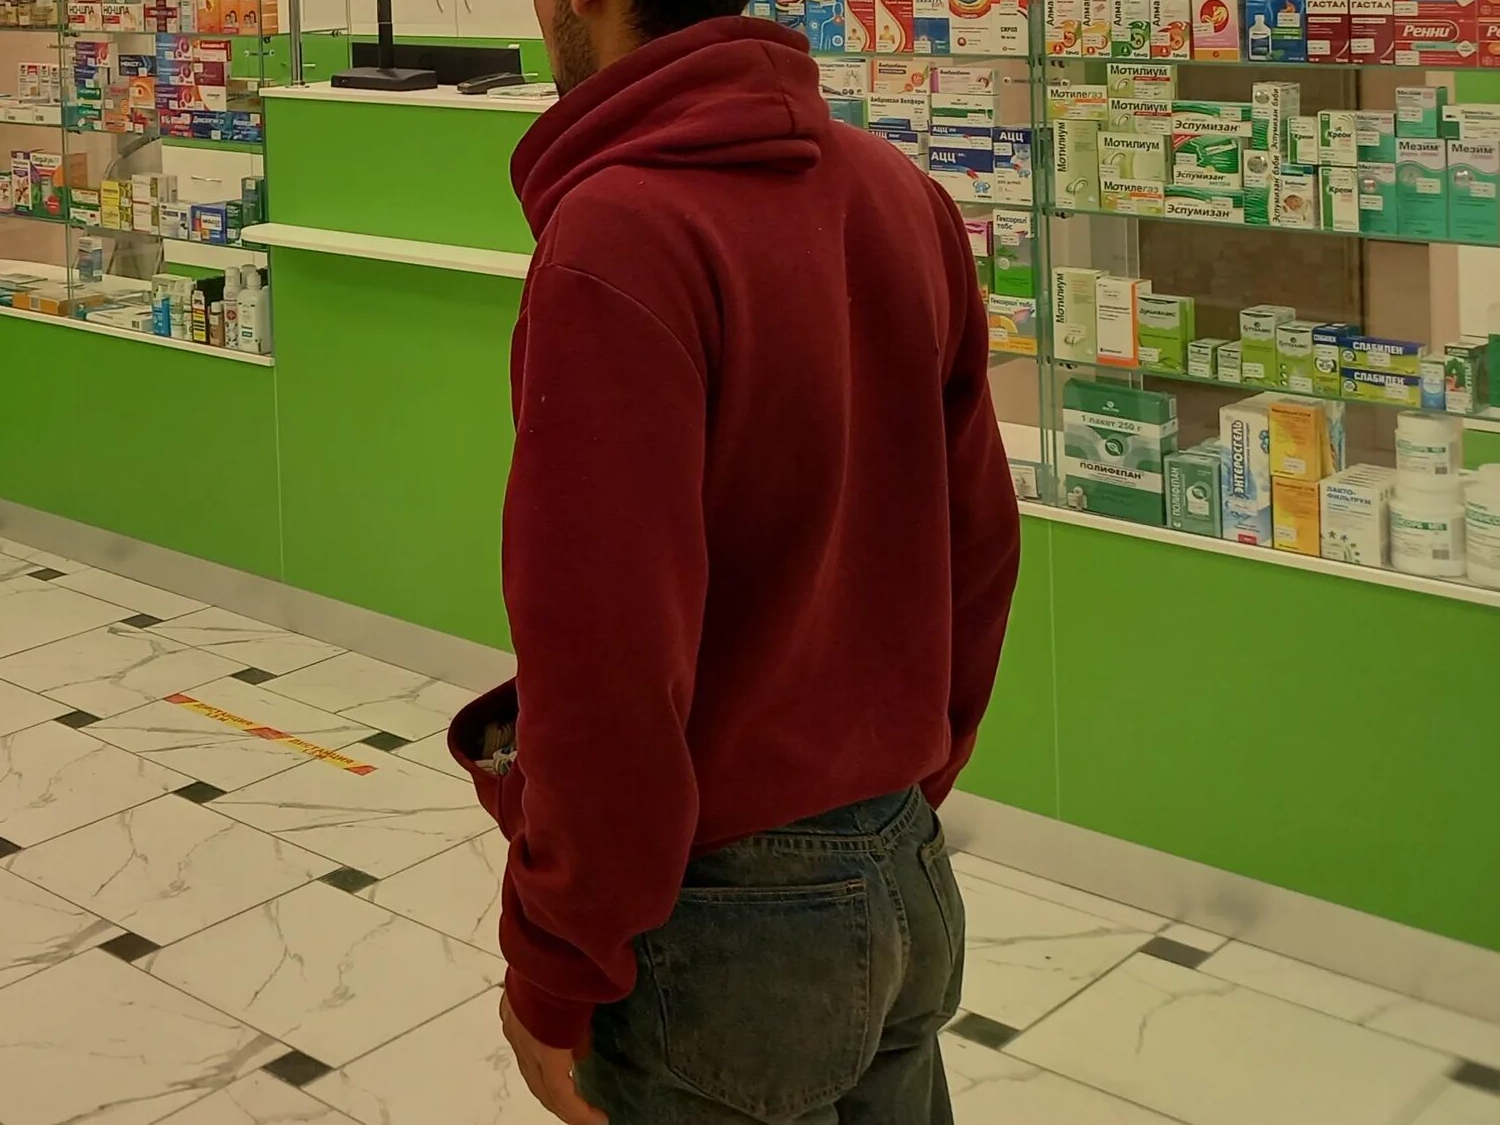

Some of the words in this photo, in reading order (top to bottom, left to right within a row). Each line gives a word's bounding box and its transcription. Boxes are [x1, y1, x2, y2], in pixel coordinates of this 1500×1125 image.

[69, 5, 94, 15] НО-ШПА
[103, 5, 130, 16] НО-ШПА
[1308, 0, 1347, 9] ГАСТАЛ
[1351, 1, 1391, 9] ГАСТАЛ
[1403, 24, 1449, 37] Ренни
[1110, 64, 1167, 77] Мотилиум
[1111, 100, 1168, 113] Мотилиум
[931, 125, 949, 135] АЦЦ
[1174, 120, 1239, 132] Эспумизан
[1272, 114, 1280, 150] Эспумизан
[1000, 131, 1024, 143] АЦЦ
[1327, 130, 1351, 140] Креон
[1057, 121, 1069, 172] Мотилиум
[1104, 137, 1160, 150] Мотилиум
[1399, 141, 1439, 152] Мезим
[1451, 143, 1494, 155] Мезим
[931, 151, 957, 164] АЦЦ
[1176, 171, 1224, 181] Эспумизан
[1329, 185, 1353, 195] Креон
[1272, 179, 1281, 223] Эспумизан
[1167, 204, 1230, 219] Эспумизан
[1056, 273, 1067, 324] Мотилиум
[1352, 341, 1404, 356] СЛАБИЛЕН
[1088, 418, 1116, 427] пакет
[1232, 420, 1244, 495] ЭНТЕРОСГЕЛЬ
[1079, 461, 1143, 480] ПОЛИФЕПАН
[1171, 467, 1181, 517] ПОЛИФЕПАН
[194, 702, 254, 726] ДИСТАНЦИЯ
[288, 737, 355, 764] ДИСТАНЦИЯ
